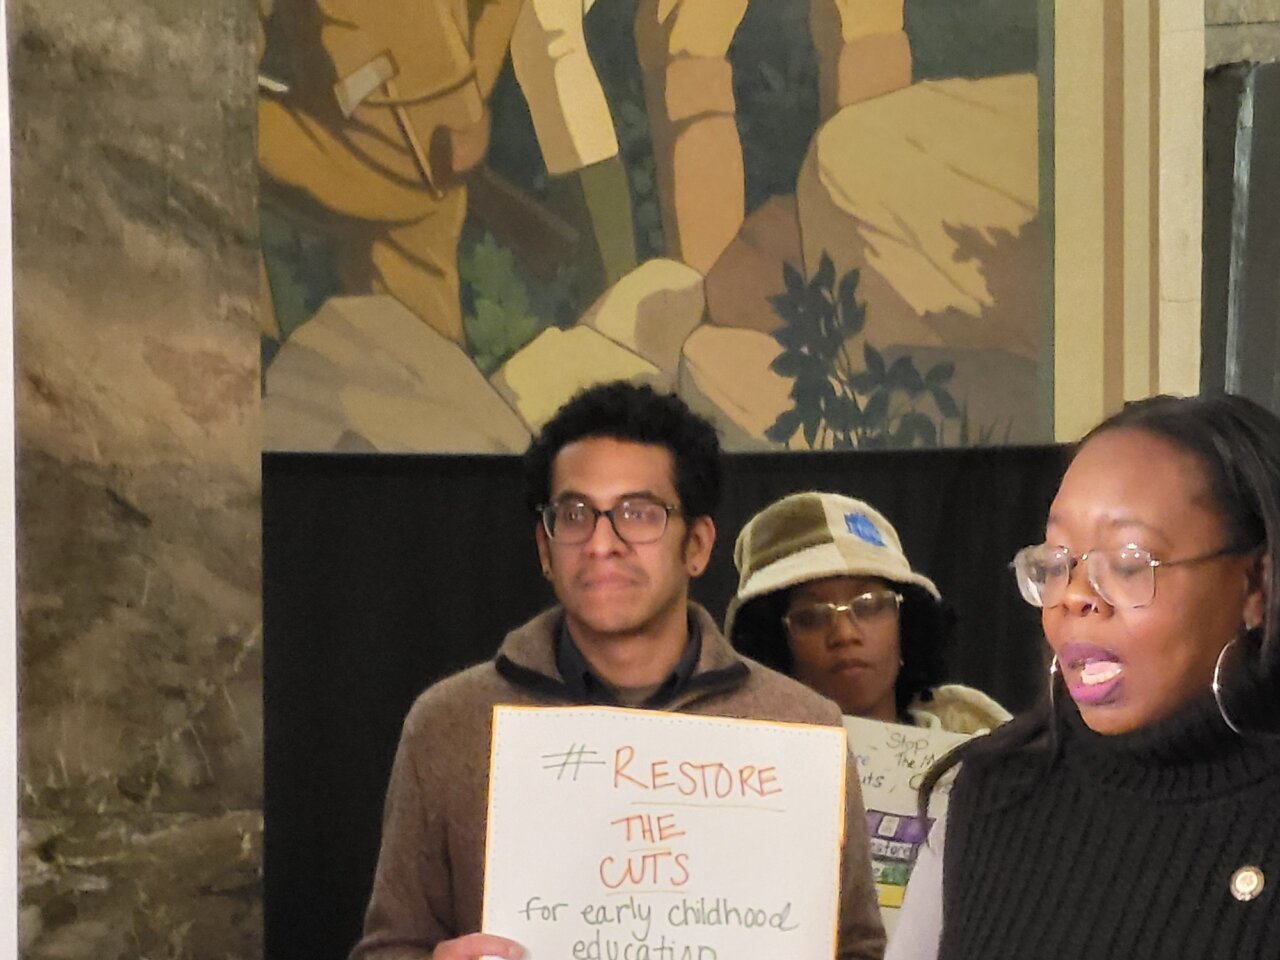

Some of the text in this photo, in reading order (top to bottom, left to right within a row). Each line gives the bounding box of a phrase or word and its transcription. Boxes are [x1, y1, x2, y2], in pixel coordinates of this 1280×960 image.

[611, 813, 686, 843] THE
[600, 850, 689, 889] CUTS
[519, 896, 800, 941] for early childhood
